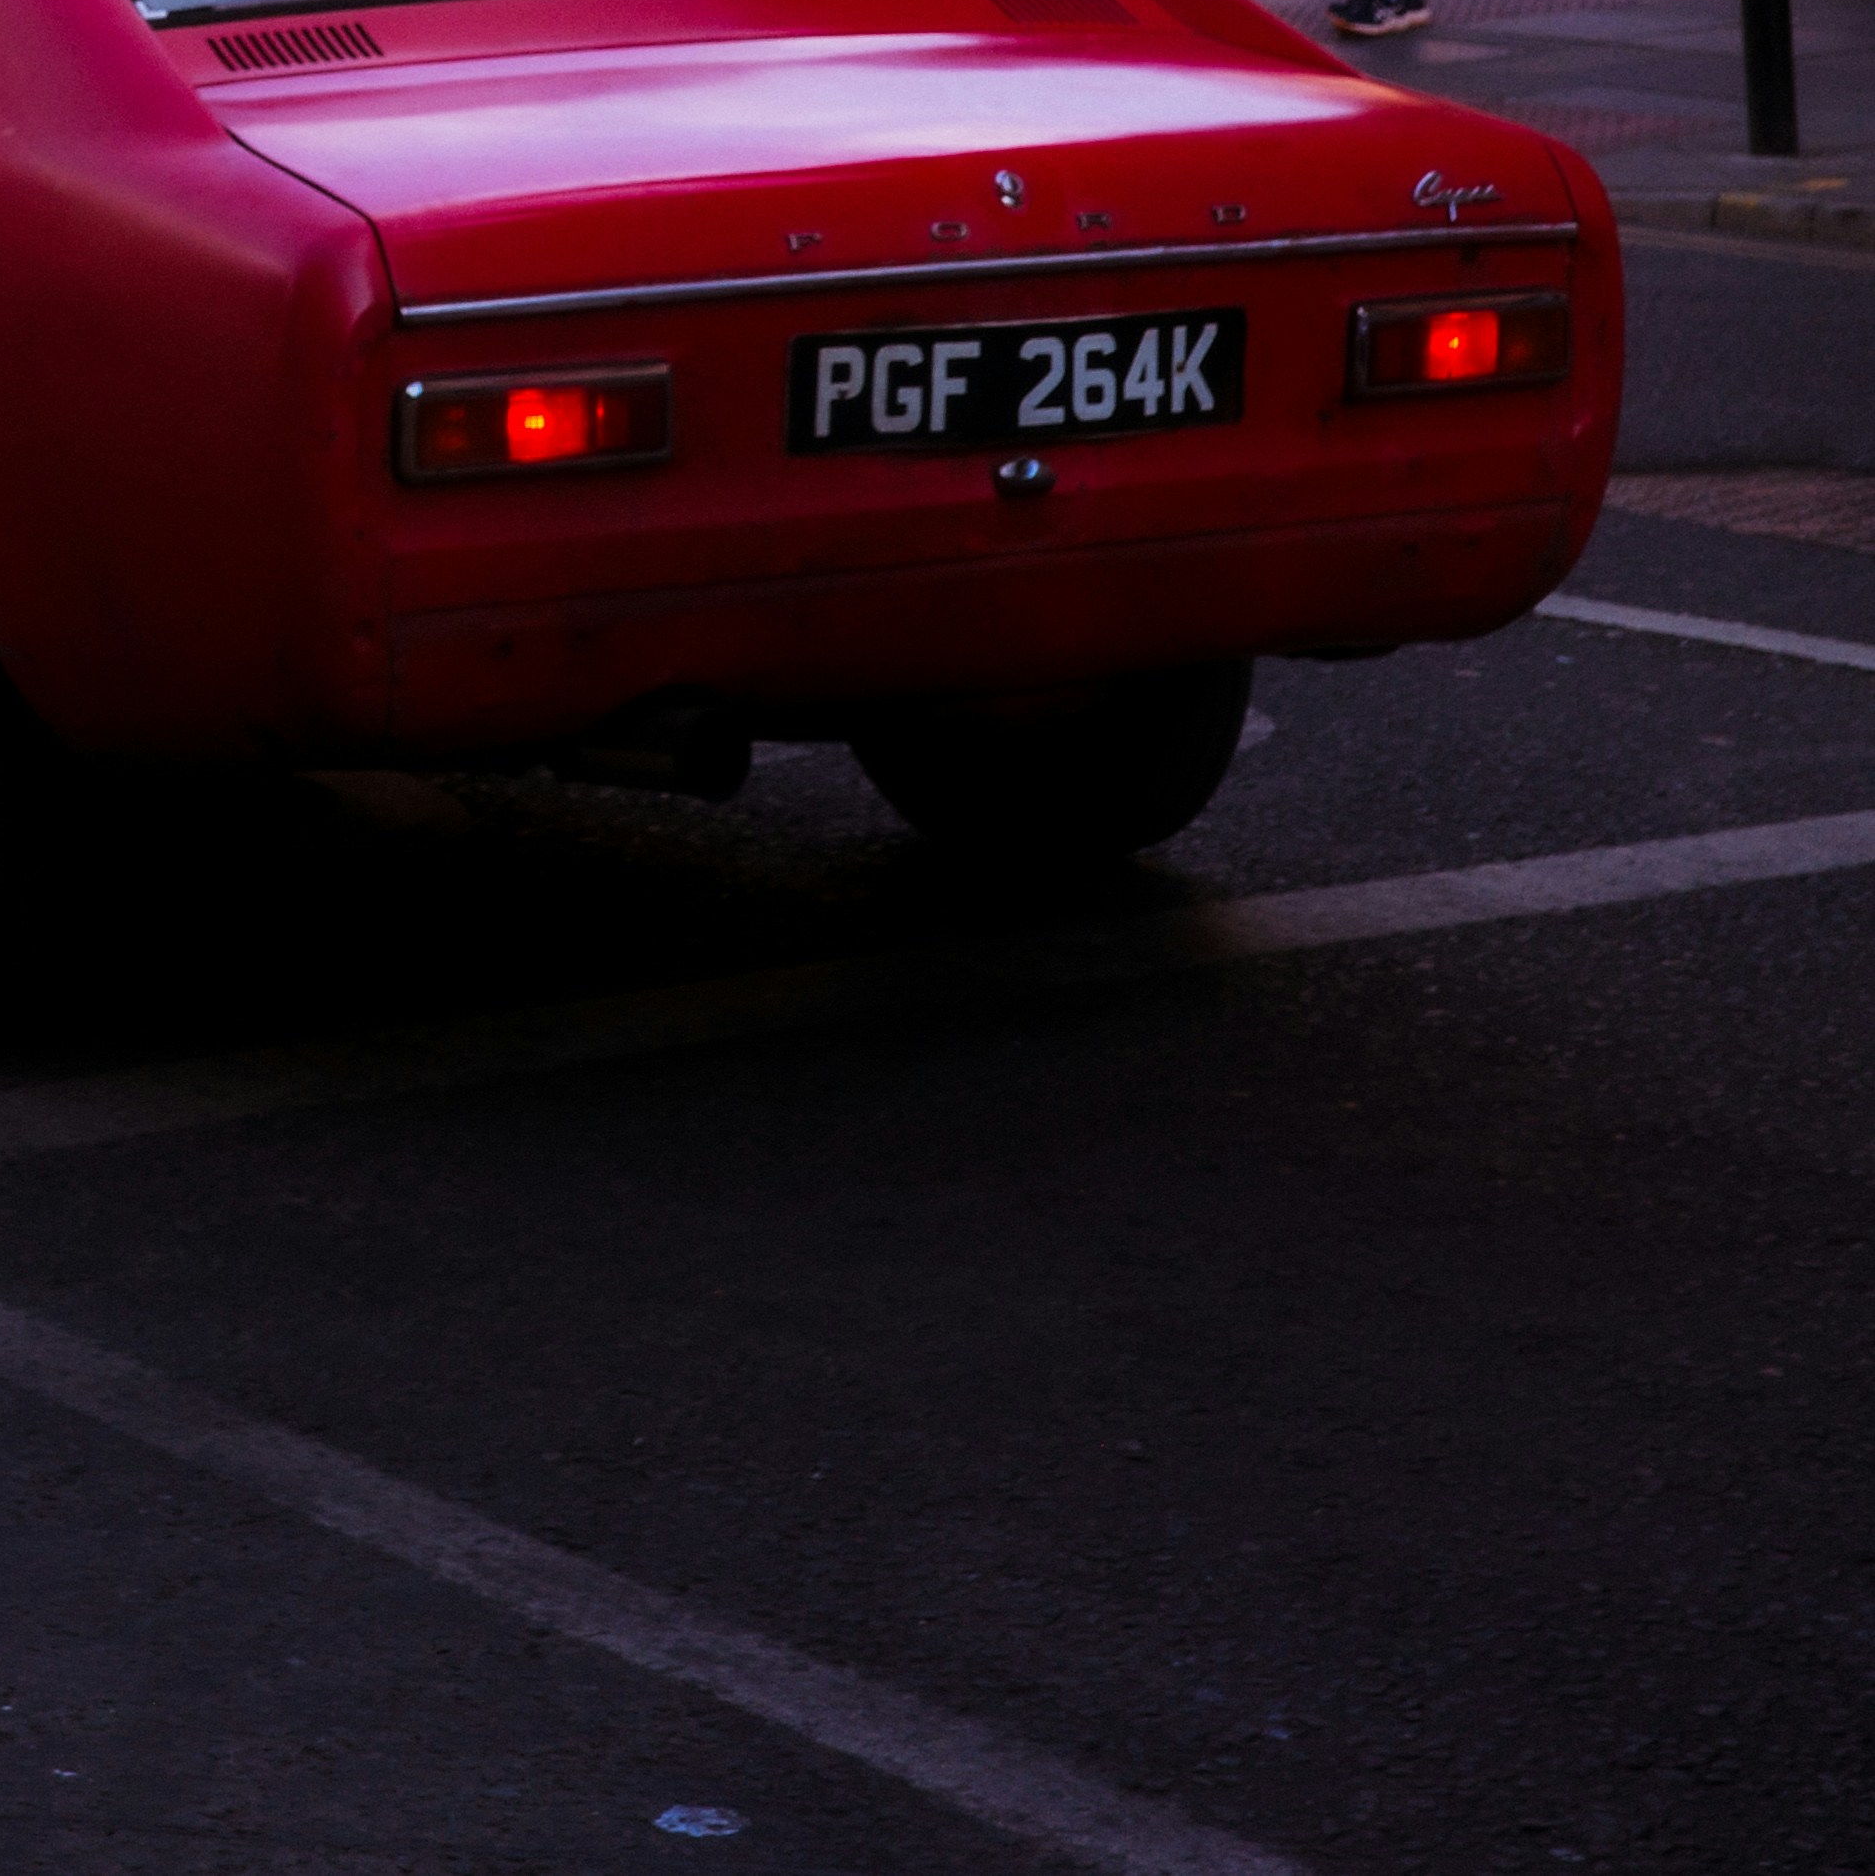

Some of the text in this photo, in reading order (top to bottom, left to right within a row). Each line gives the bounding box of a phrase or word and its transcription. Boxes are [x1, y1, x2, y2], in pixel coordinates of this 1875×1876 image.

[786, 203, 1247, 252] FORD
[813, 321, 1220, 439] PGF 264K
